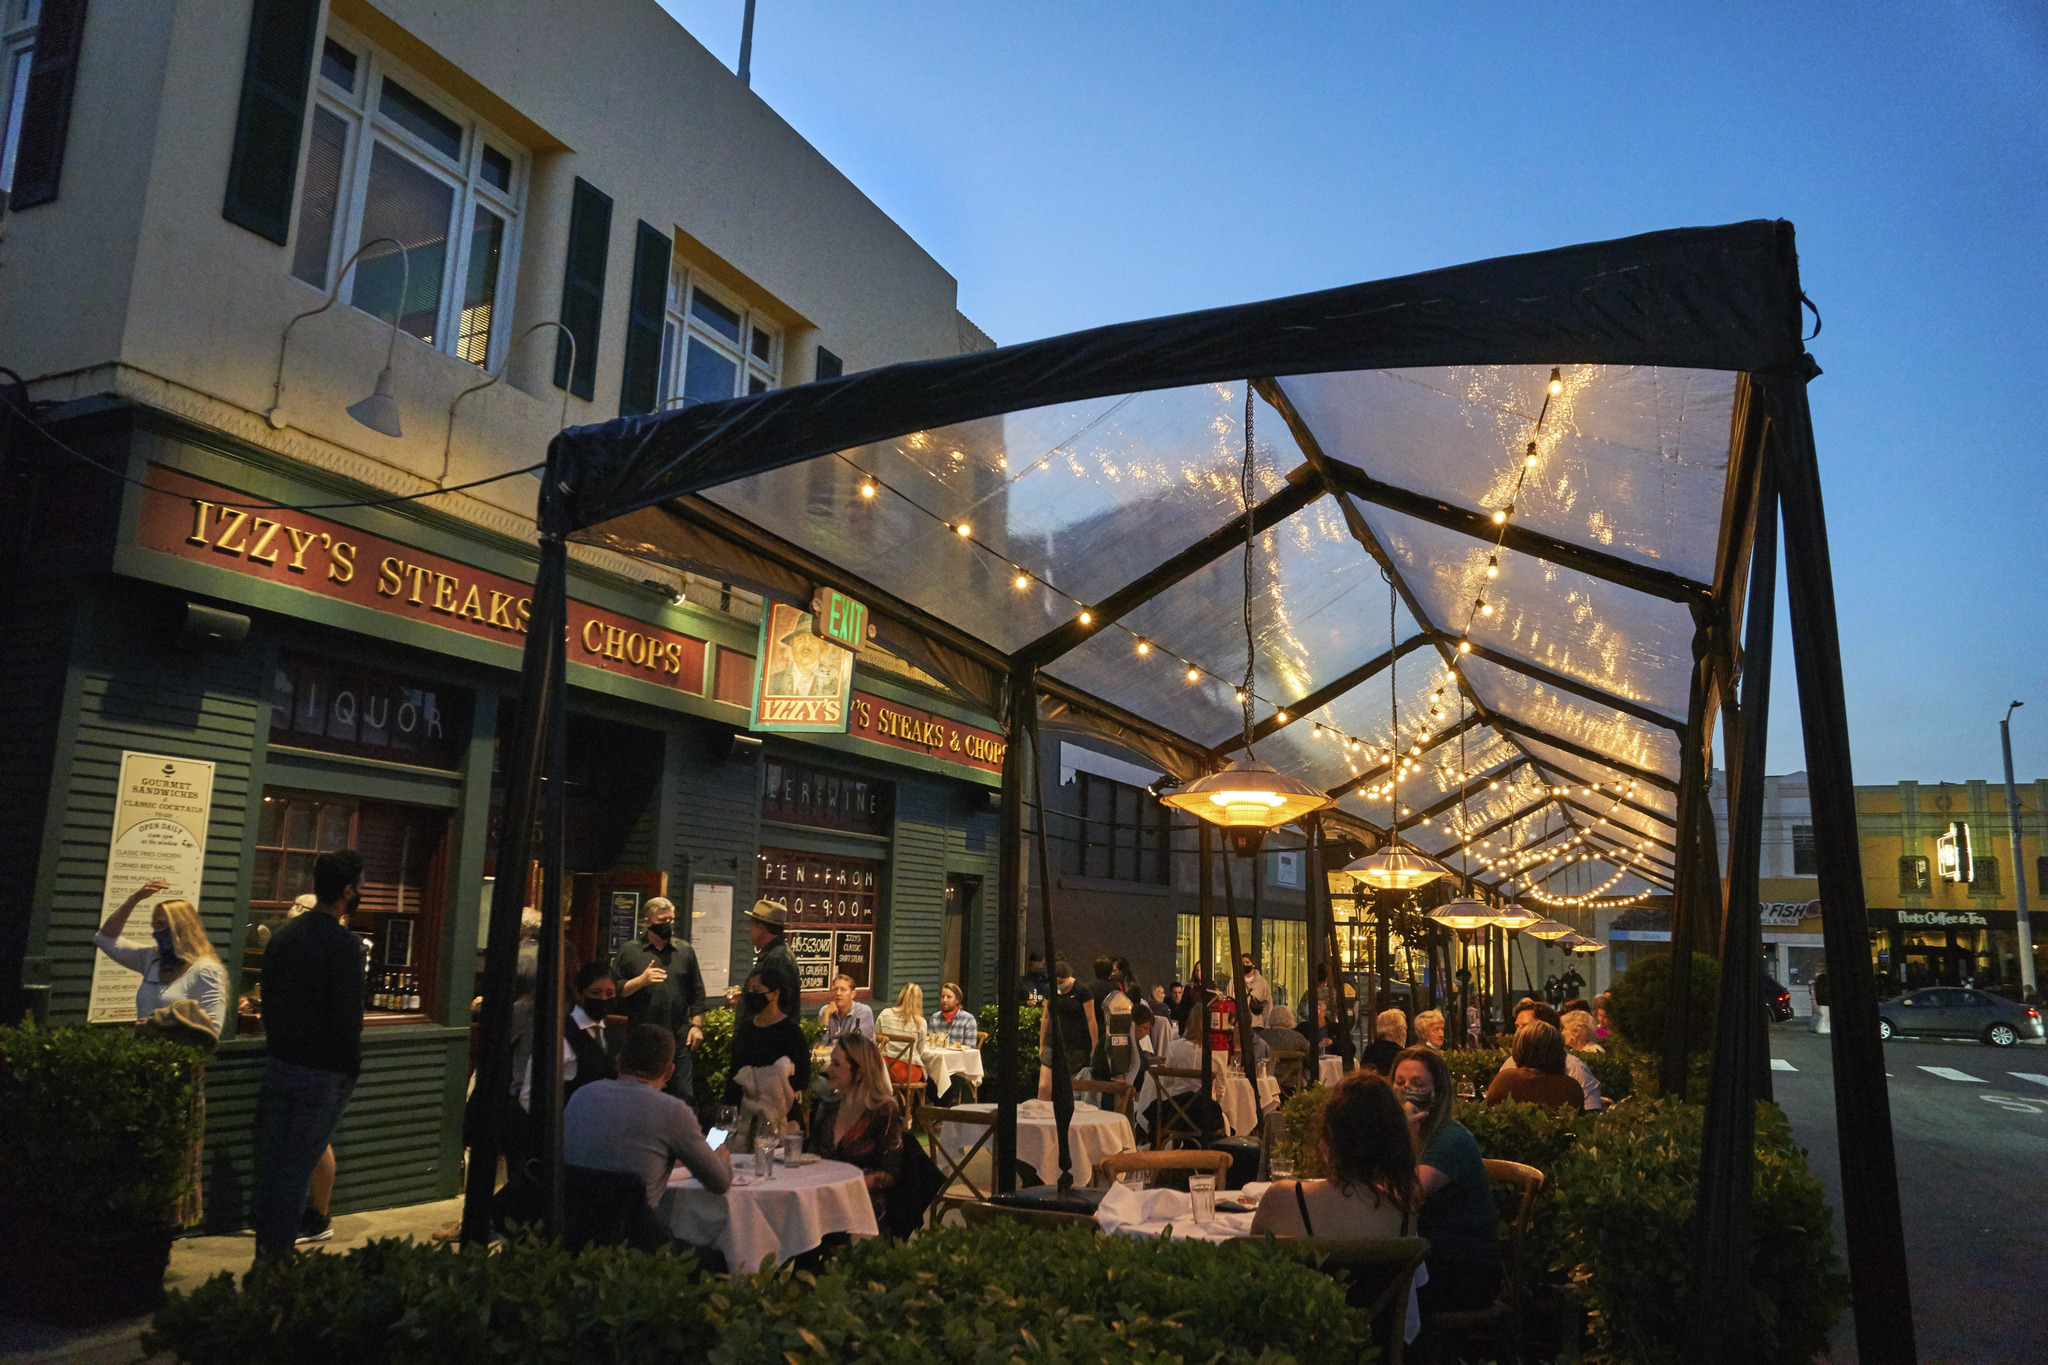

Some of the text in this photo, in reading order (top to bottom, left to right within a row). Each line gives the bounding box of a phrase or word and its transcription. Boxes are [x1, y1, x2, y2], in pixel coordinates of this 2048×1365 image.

[189, 500, 532, 632] IZZY'S STEAKS
[829, 592, 863, 646] EXIT
[582, 620, 682, 674] CHOPS
[272, 684, 442, 739] IQUOR
[762, 699, 840, 721] IZZY'S
[878, 708, 943, 748] STEAKS
[950, 730, 960, 752] &
[132, 785, 198, 799] SANDWICHES
[141, 778, 191, 790] GOURMET
[123, 800, 203, 813] CLASSIC COCKTAILS
[828, 789, 876, 813] WINE
[139, 823, 183, 834] OPEN DAILY
[765, 863, 872, 886] PEN FROM
[823, 899, 859, 916] 9:00
[1925, 911, 1958, 925] Coffee
[1966, 911, 1987, 925] Tea
[843, 943, 862, 952] CLASSIC
